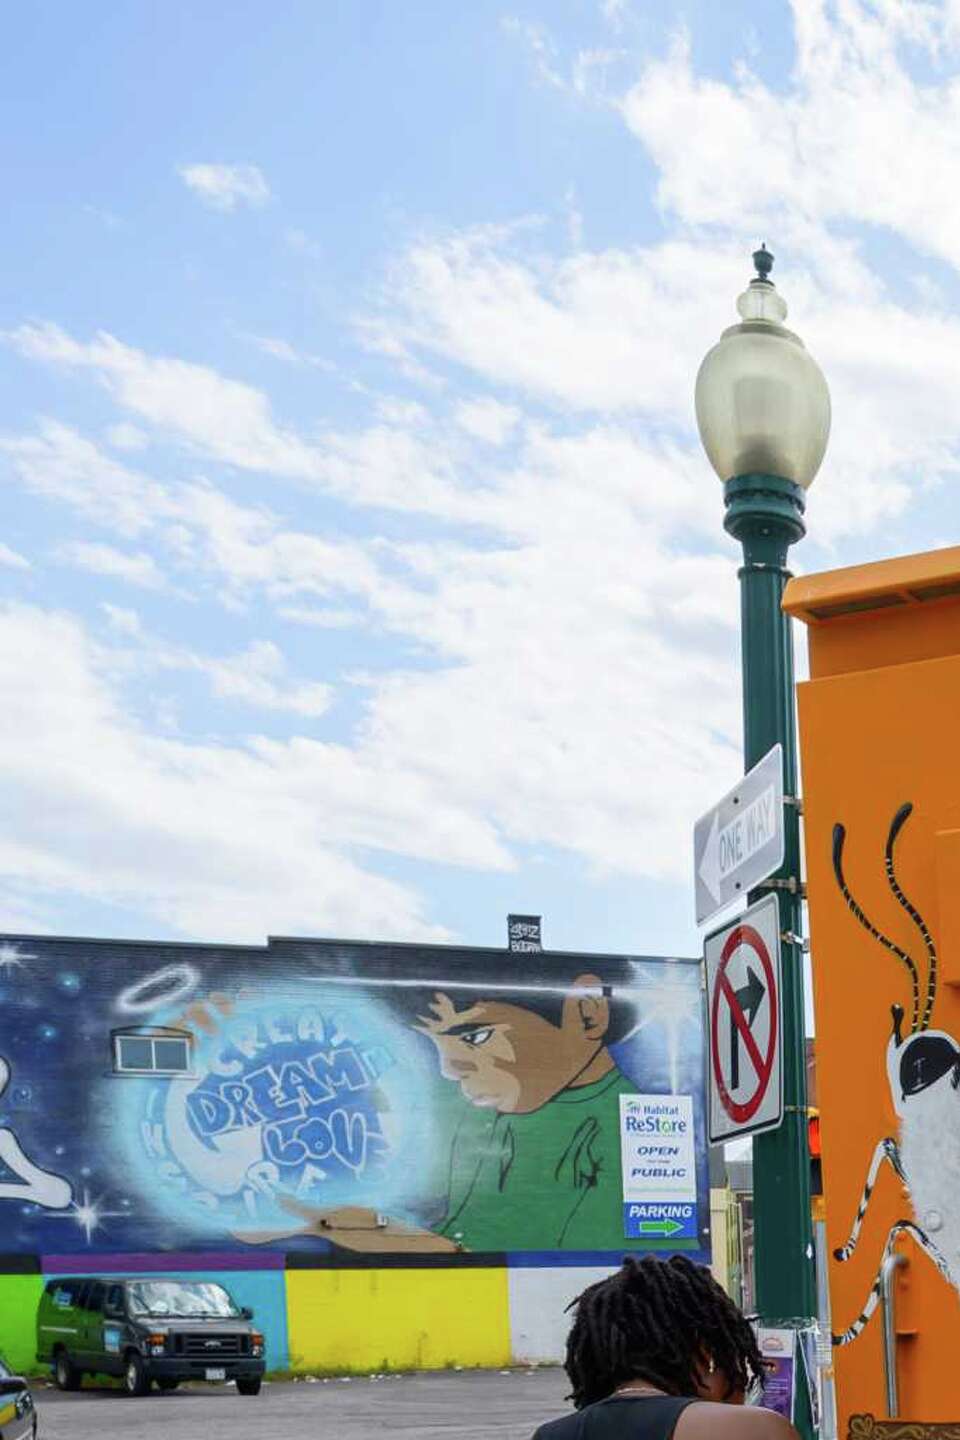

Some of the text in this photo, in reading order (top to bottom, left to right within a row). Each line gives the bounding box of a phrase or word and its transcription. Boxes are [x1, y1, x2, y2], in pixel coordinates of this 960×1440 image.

[720, 796, 772, 872] ONE WAY
[186, 1047, 370, 1136] DREAM
[644, 1104, 679, 1116] Habitat
[626, 1116, 687, 1134] ReStore
[637, 1146, 680, 1157] OPEN
[631, 1168, 687, 1178] PUBLIC
[629, 1205, 693, 1218] PARKING
